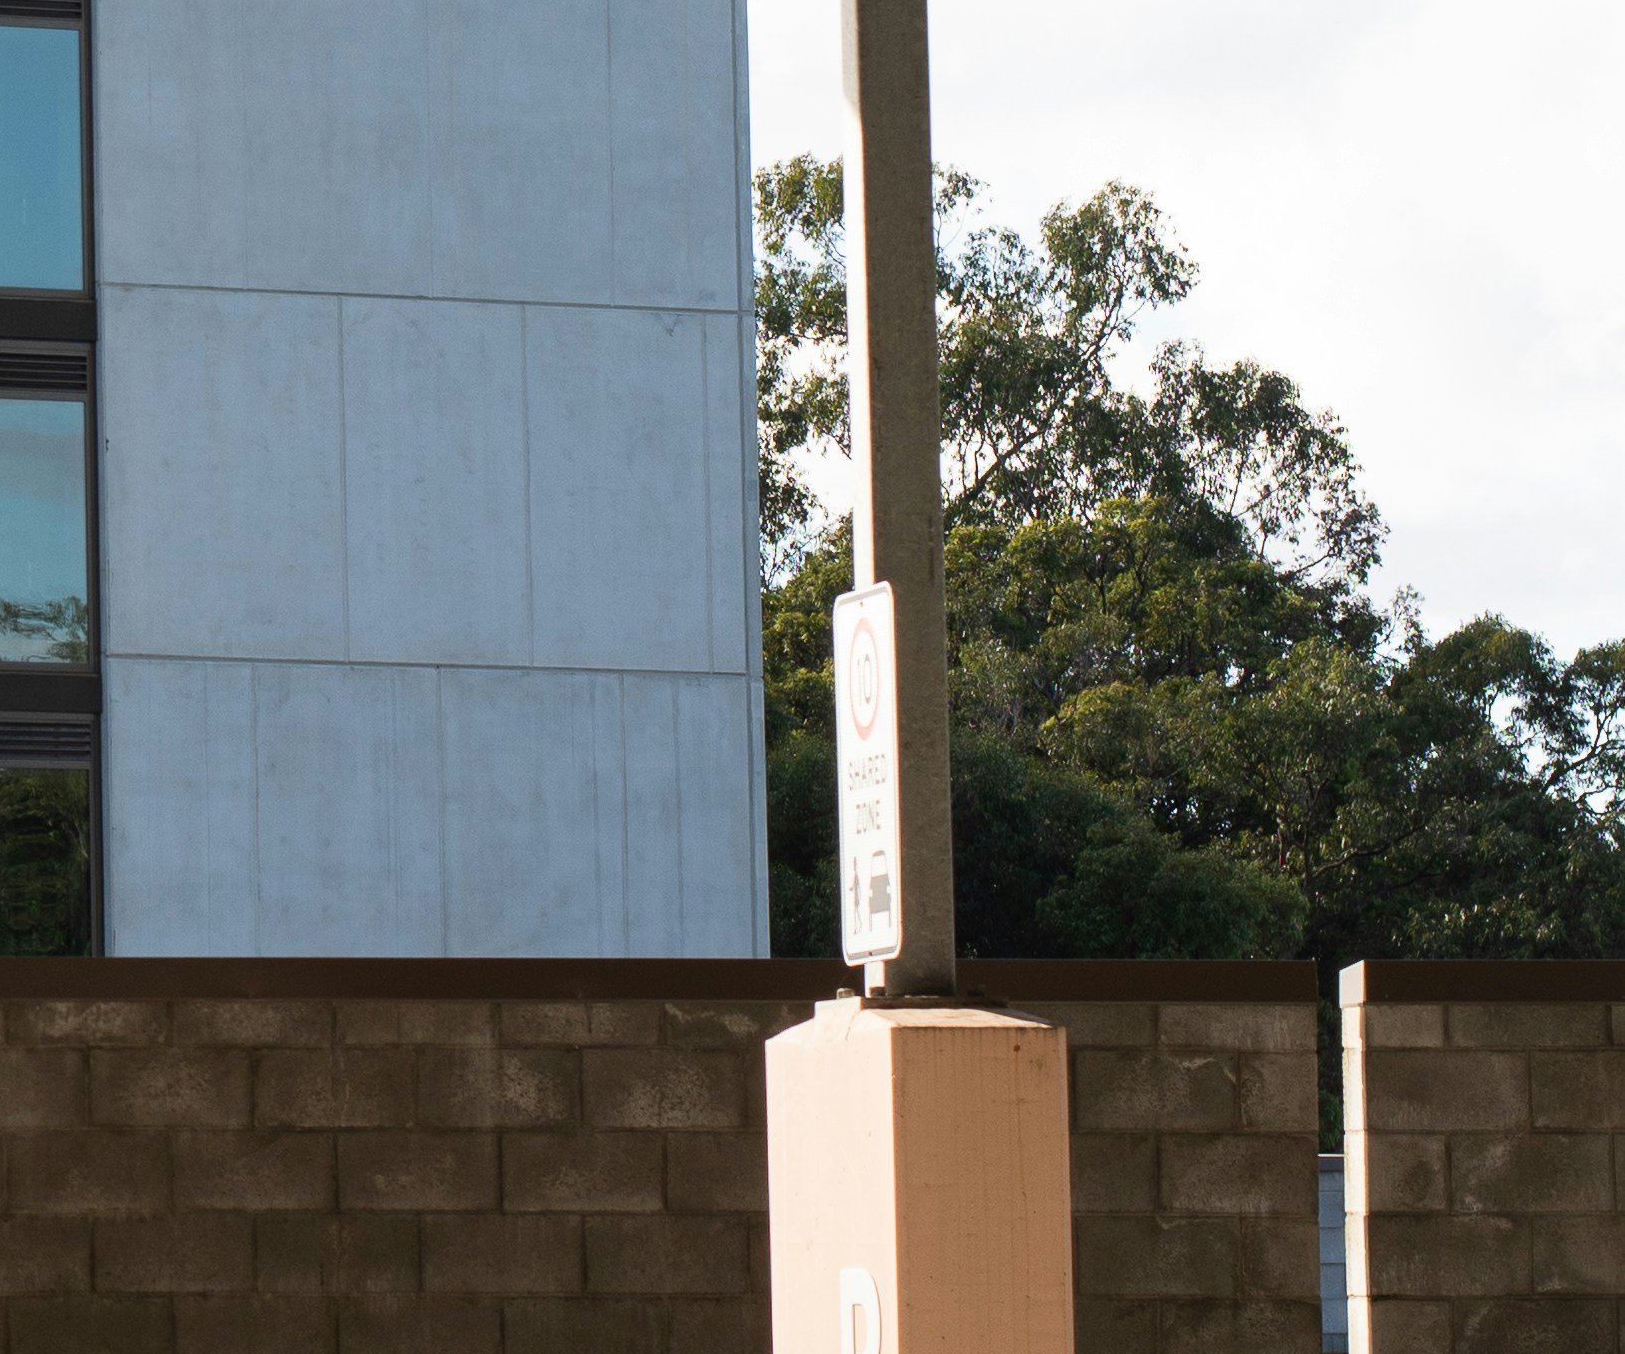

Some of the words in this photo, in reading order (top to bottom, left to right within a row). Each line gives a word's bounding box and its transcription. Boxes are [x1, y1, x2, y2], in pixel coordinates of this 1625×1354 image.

[857, 654, 873, 707] 10
[848, 753, 887, 792] SHARED
[855, 798, 882, 835] ZONE
